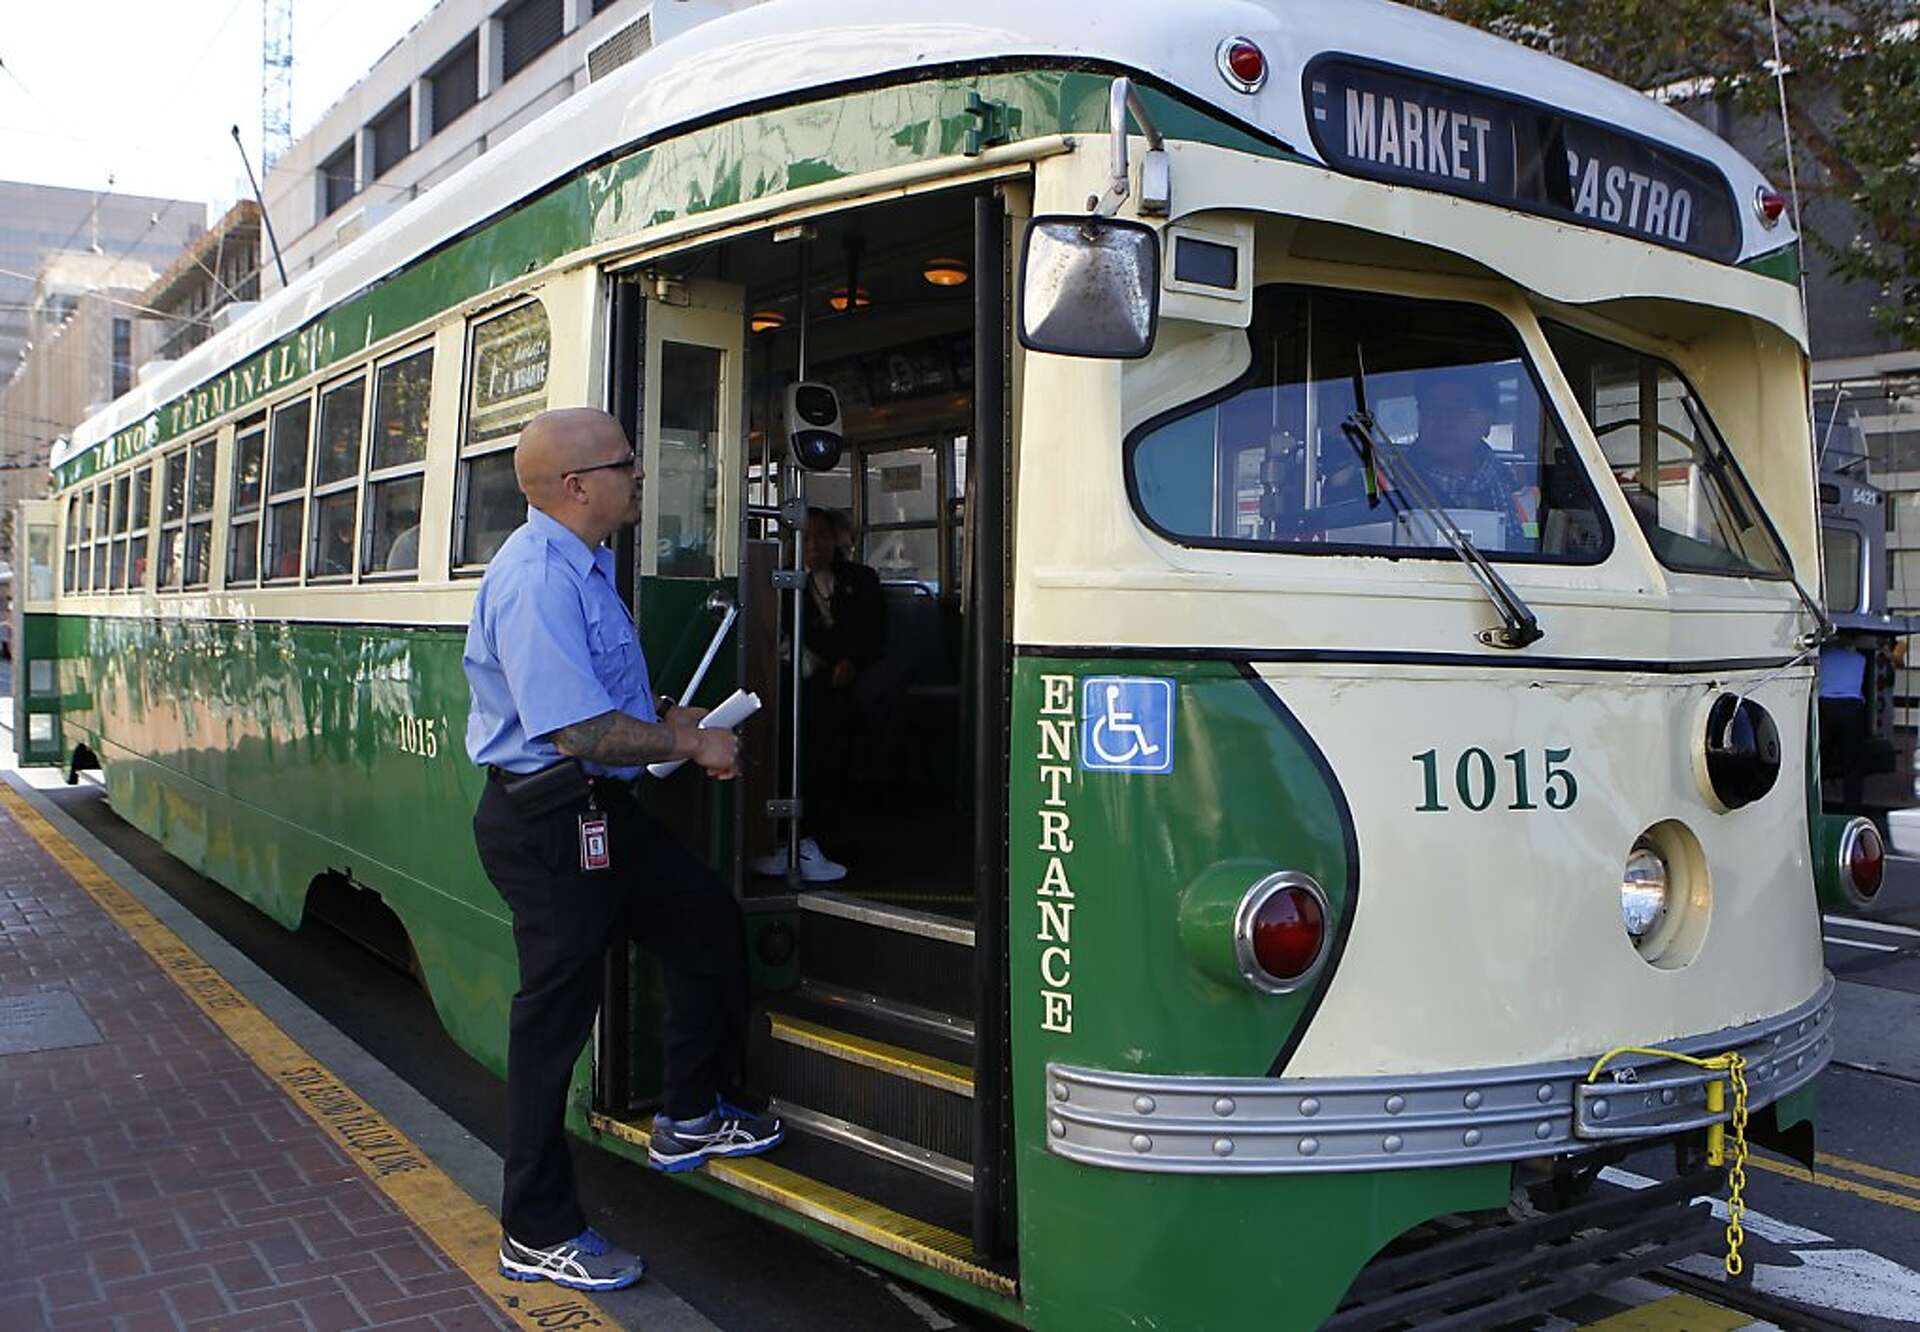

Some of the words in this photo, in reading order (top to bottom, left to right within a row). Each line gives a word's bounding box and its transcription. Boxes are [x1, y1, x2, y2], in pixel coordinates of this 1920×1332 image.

[1346, 87, 1491, 184] MARKET
[171, 343, 297, 434] TERMINAL
[398, 713, 437, 758] 1015
[1411, 746, 1579, 813] 1015
[1036, 674, 1075, 1035] ENTRANCE
[526, 1300, 603, 1332] USE
